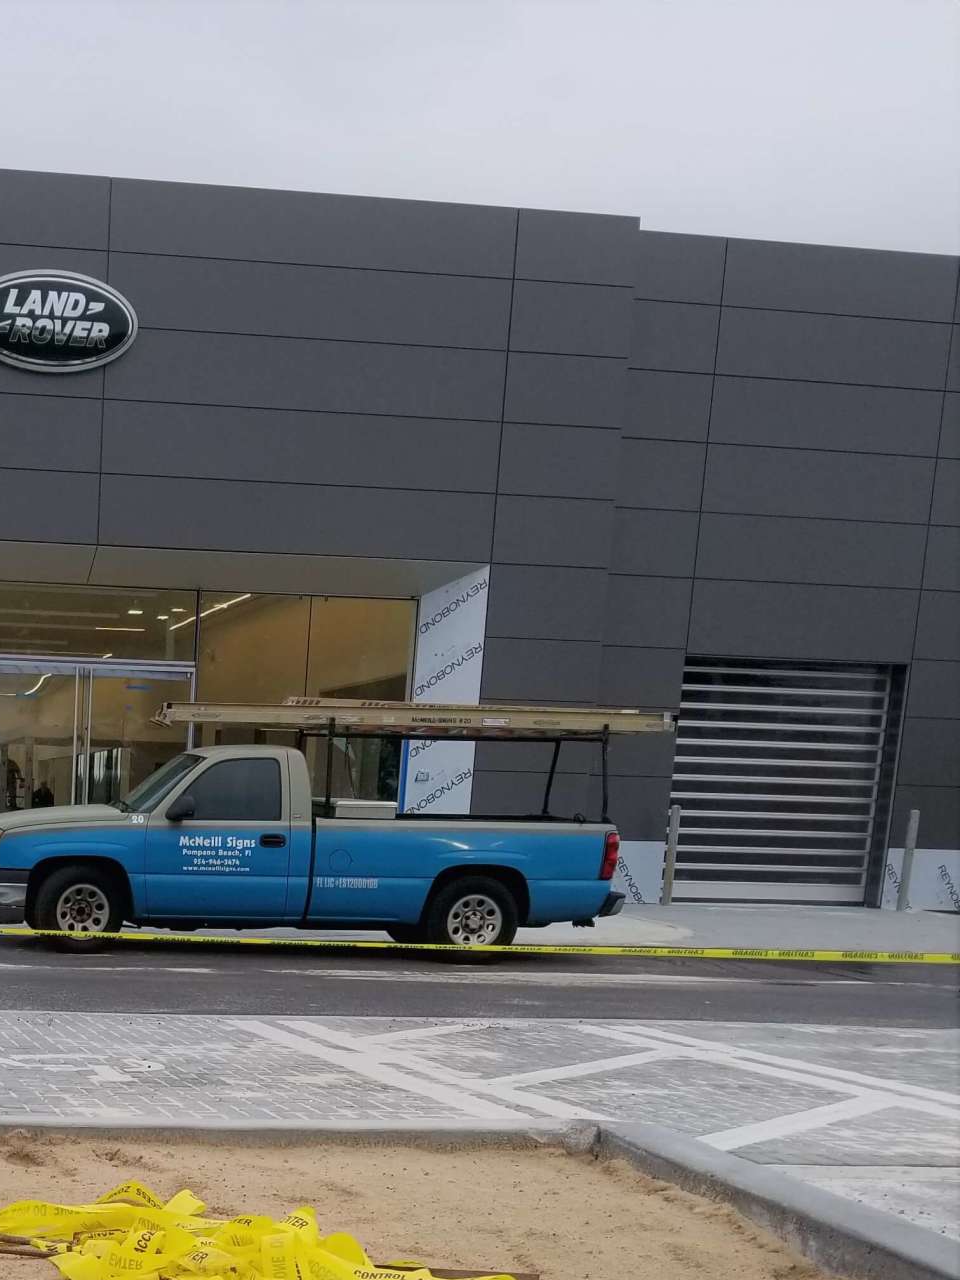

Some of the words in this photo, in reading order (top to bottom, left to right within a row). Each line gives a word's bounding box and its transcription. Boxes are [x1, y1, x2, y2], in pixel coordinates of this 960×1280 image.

[3, 288, 86, 318] LAND
[8, 316, 110, 348] ROVER
[419, 579, 488, 635] REYNOBOND
[414, 642, 483, 697] REYNOBOND
[131, 815, 144, 824] 20
[179, 835, 222, 847] McNeill
[226, 836, 256, 850] Signs
[182, 849, 216, 857] Pompano
[353, 1269, 407, 1280] CONTROL
